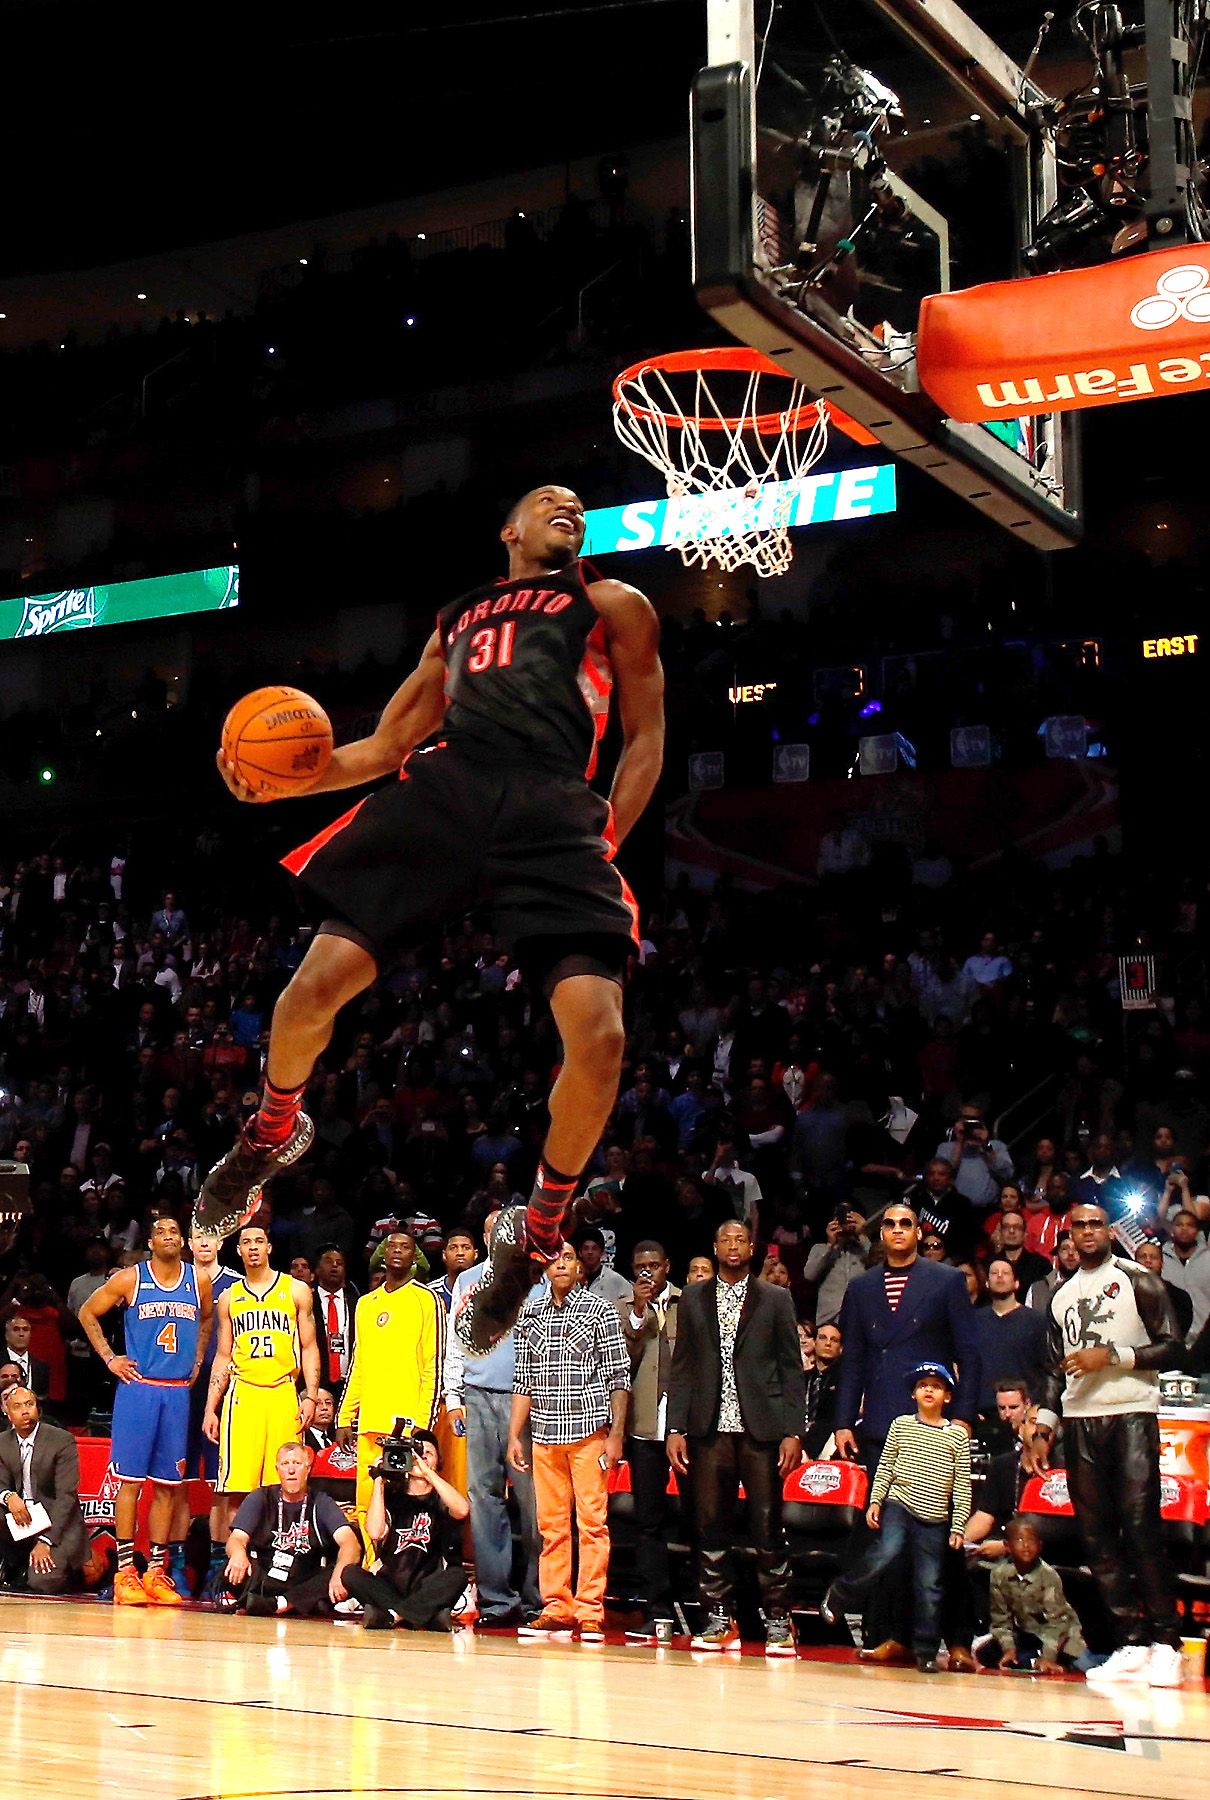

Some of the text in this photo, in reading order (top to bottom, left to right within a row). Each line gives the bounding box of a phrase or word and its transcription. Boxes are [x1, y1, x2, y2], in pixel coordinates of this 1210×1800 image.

[976, 363, 1154, 408] Farm
[25, 589, 86, 635] Sprite
[447, 589, 573, 646] ORONTO
[467, 621, 516, 673] 31
[1143, 635, 1198, 658] EAST
[138, 1302, 196, 1321] NEW YORK
[232, 1310, 290, 1337] INDIANA
[156, 1321, 177, 1354] 4
[250, 1335, 272, 1359] 25
